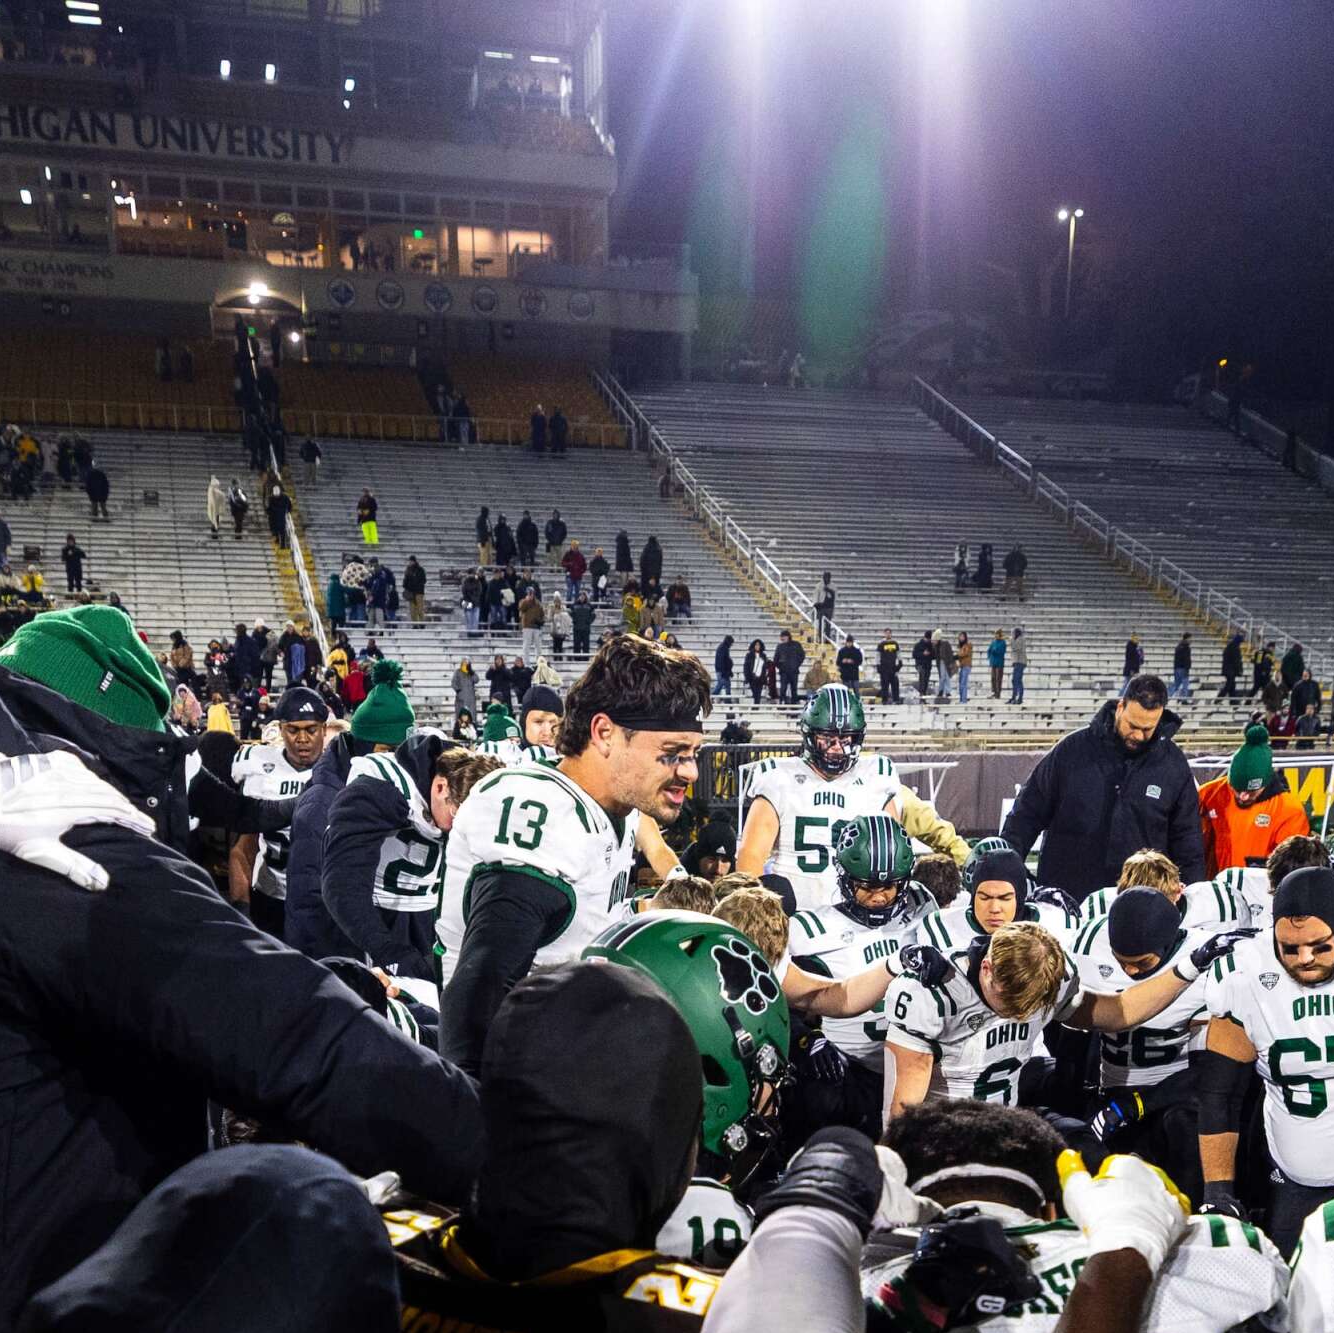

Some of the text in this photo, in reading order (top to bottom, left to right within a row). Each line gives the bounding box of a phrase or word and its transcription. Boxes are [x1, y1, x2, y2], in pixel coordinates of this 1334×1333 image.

[131, 113, 345, 164] UNIVERSITY
[279, 780, 306, 796] OHI
[814, 791, 845, 809] OHIO
[494, 796, 548, 850] 13
[383, 828, 442, 896] 2
[863, 938, 899, 965] OHIO
[894, 991, 912, 1020] 6
[986, 1022, 1030, 1050] OHIO
